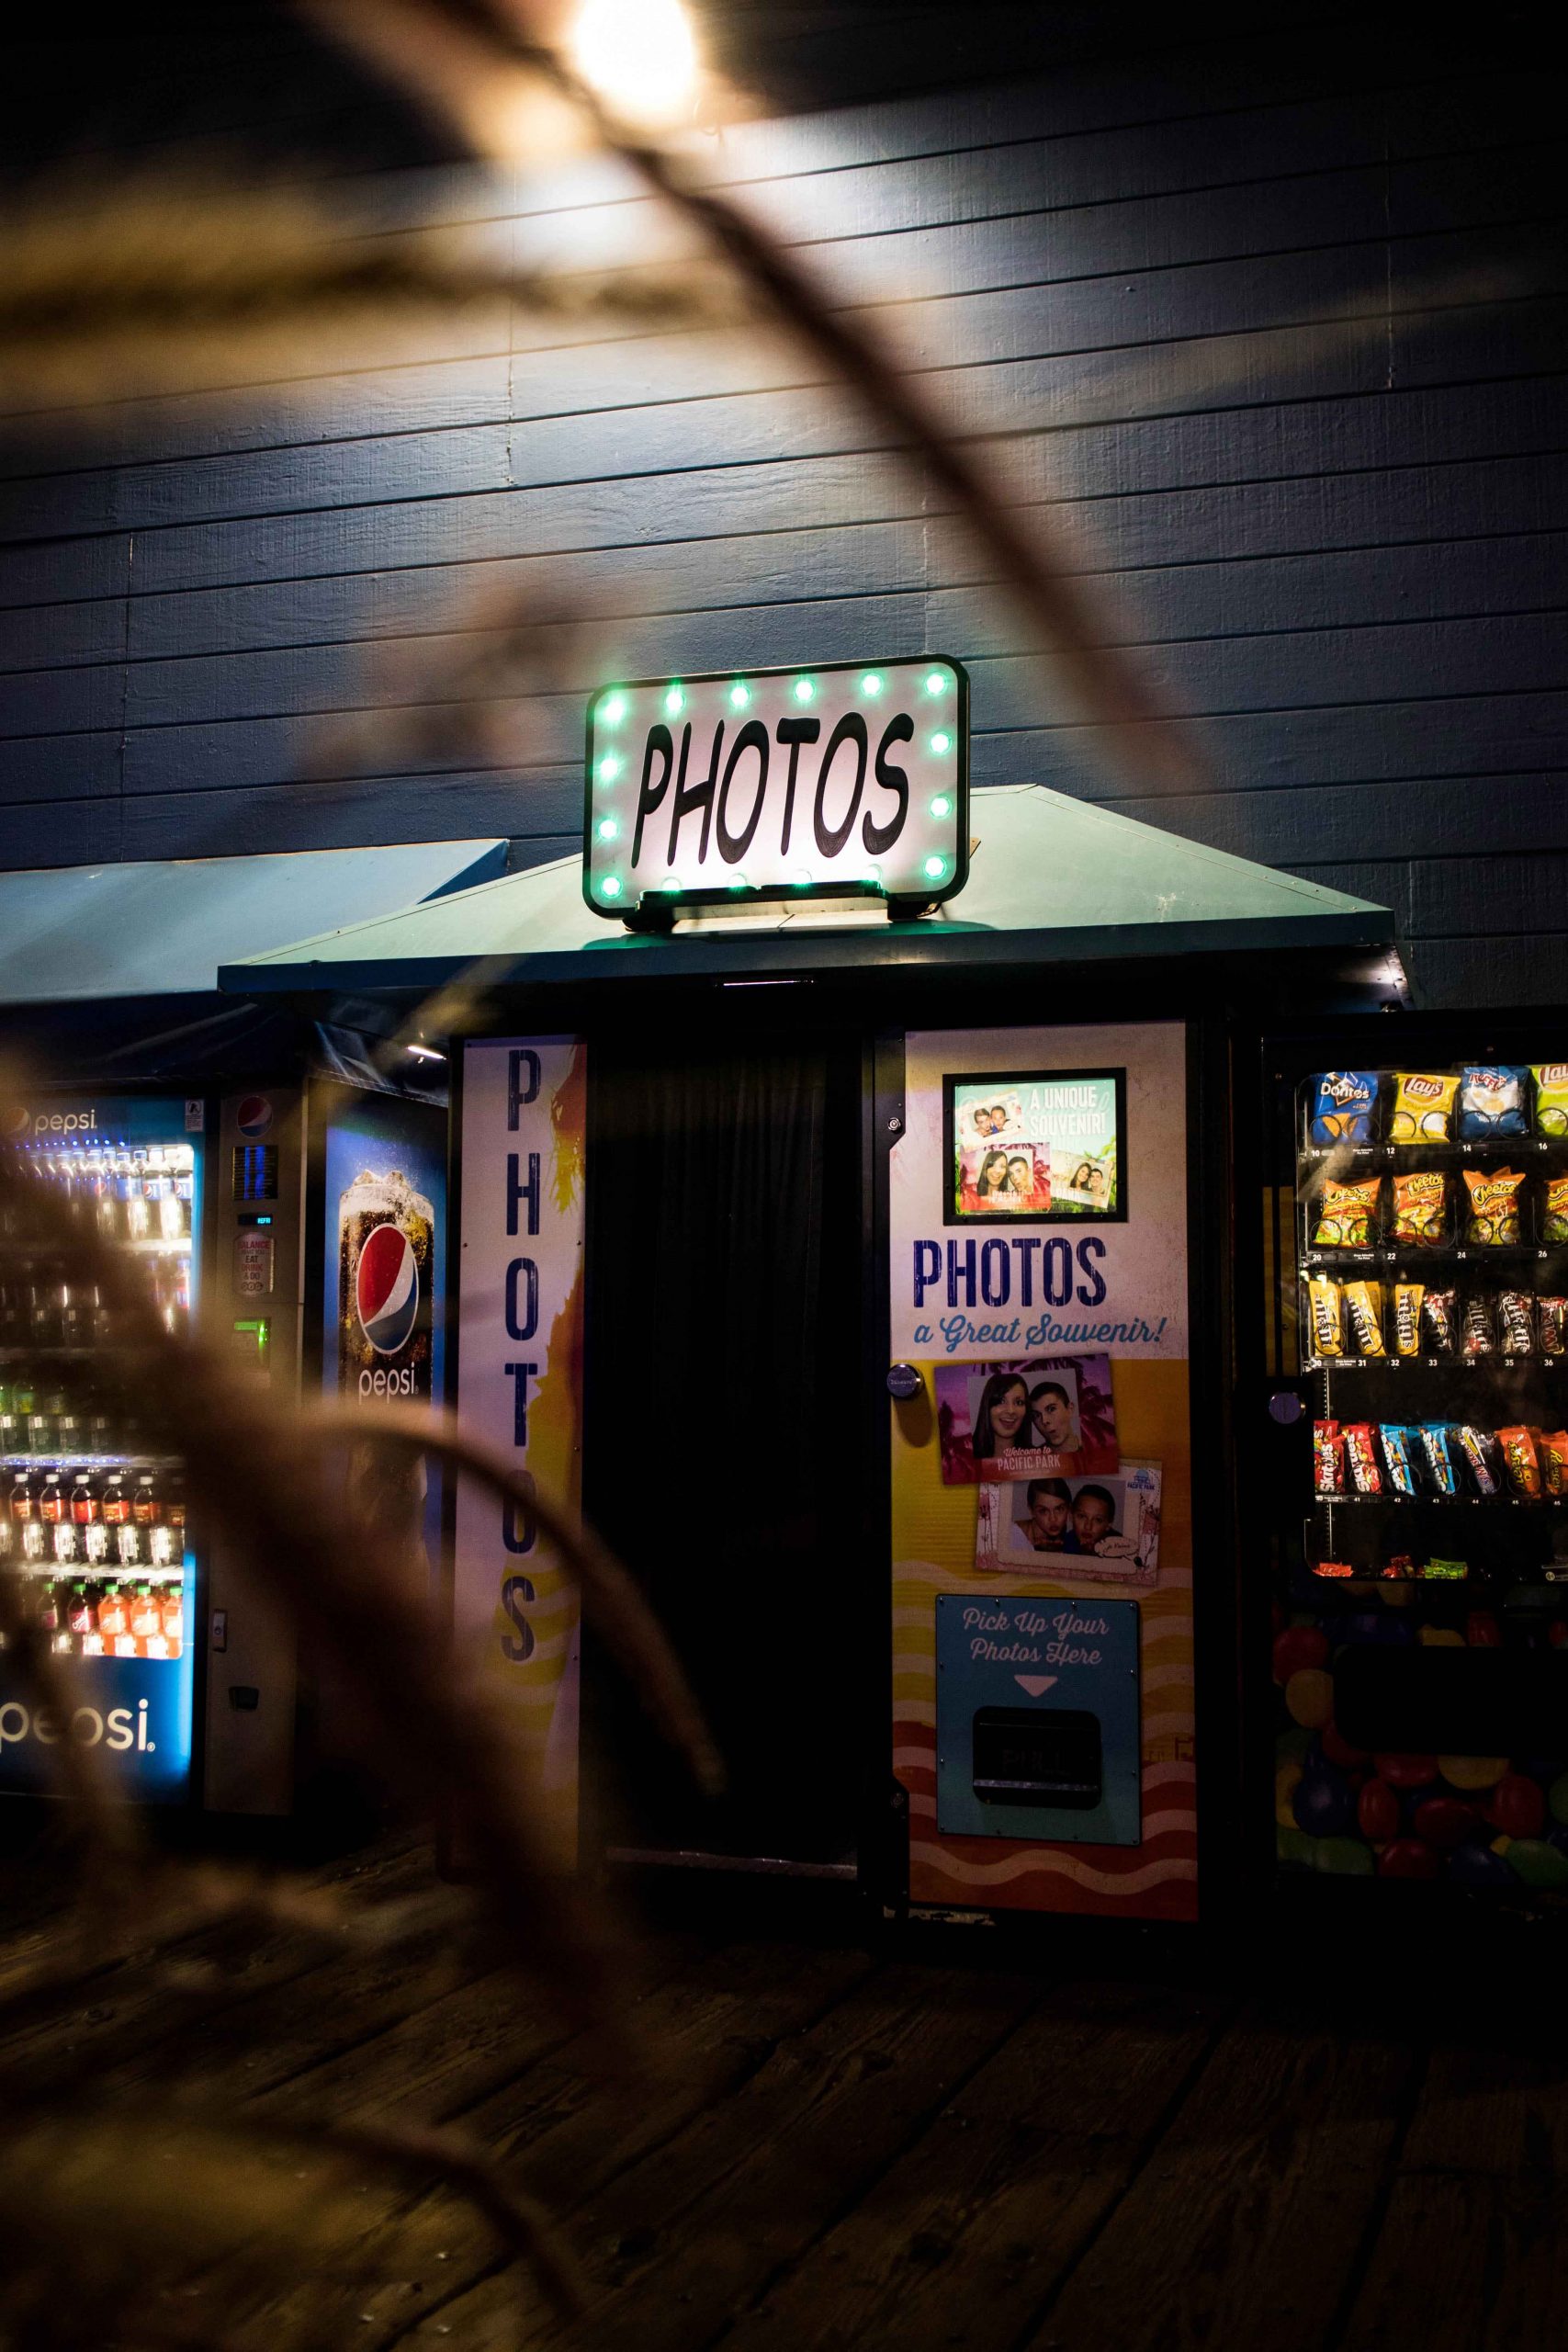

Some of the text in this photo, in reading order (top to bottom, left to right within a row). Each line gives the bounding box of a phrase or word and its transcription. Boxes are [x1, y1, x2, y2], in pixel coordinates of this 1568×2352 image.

[631, 711, 915, 869] PHOTOS
[1030, 1086, 1097, 1111] A UNIQUE
[1320, 1082, 1371, 1100] Doritos
[1404, 1077, 1443, 1097] Lay's
[34, 1109, 96, 1136] pepsi
[1029, 1112, 1107, 1137] SOUVENIR!
[1472, 1182, 1517, 1207] Cheetos
[245, 1255, 258, 1263] EAT
[913, 1237, 1108, 1307] PHOTOS
[913, 1313, 1168, 1353] a Great Souvenir!
[501, 1049, 542, 1662] PHOTOS
[358, 1361, 415, 1405] pepsi
[997, 1454, 1061, 1471] PACIFIC PARK
[1003, 1445, 1052, 1457] Welcome to
[962, 1607, 1110, 1641] Pick Up Your
[970, 1637, 1103, 1667] Photos Here
